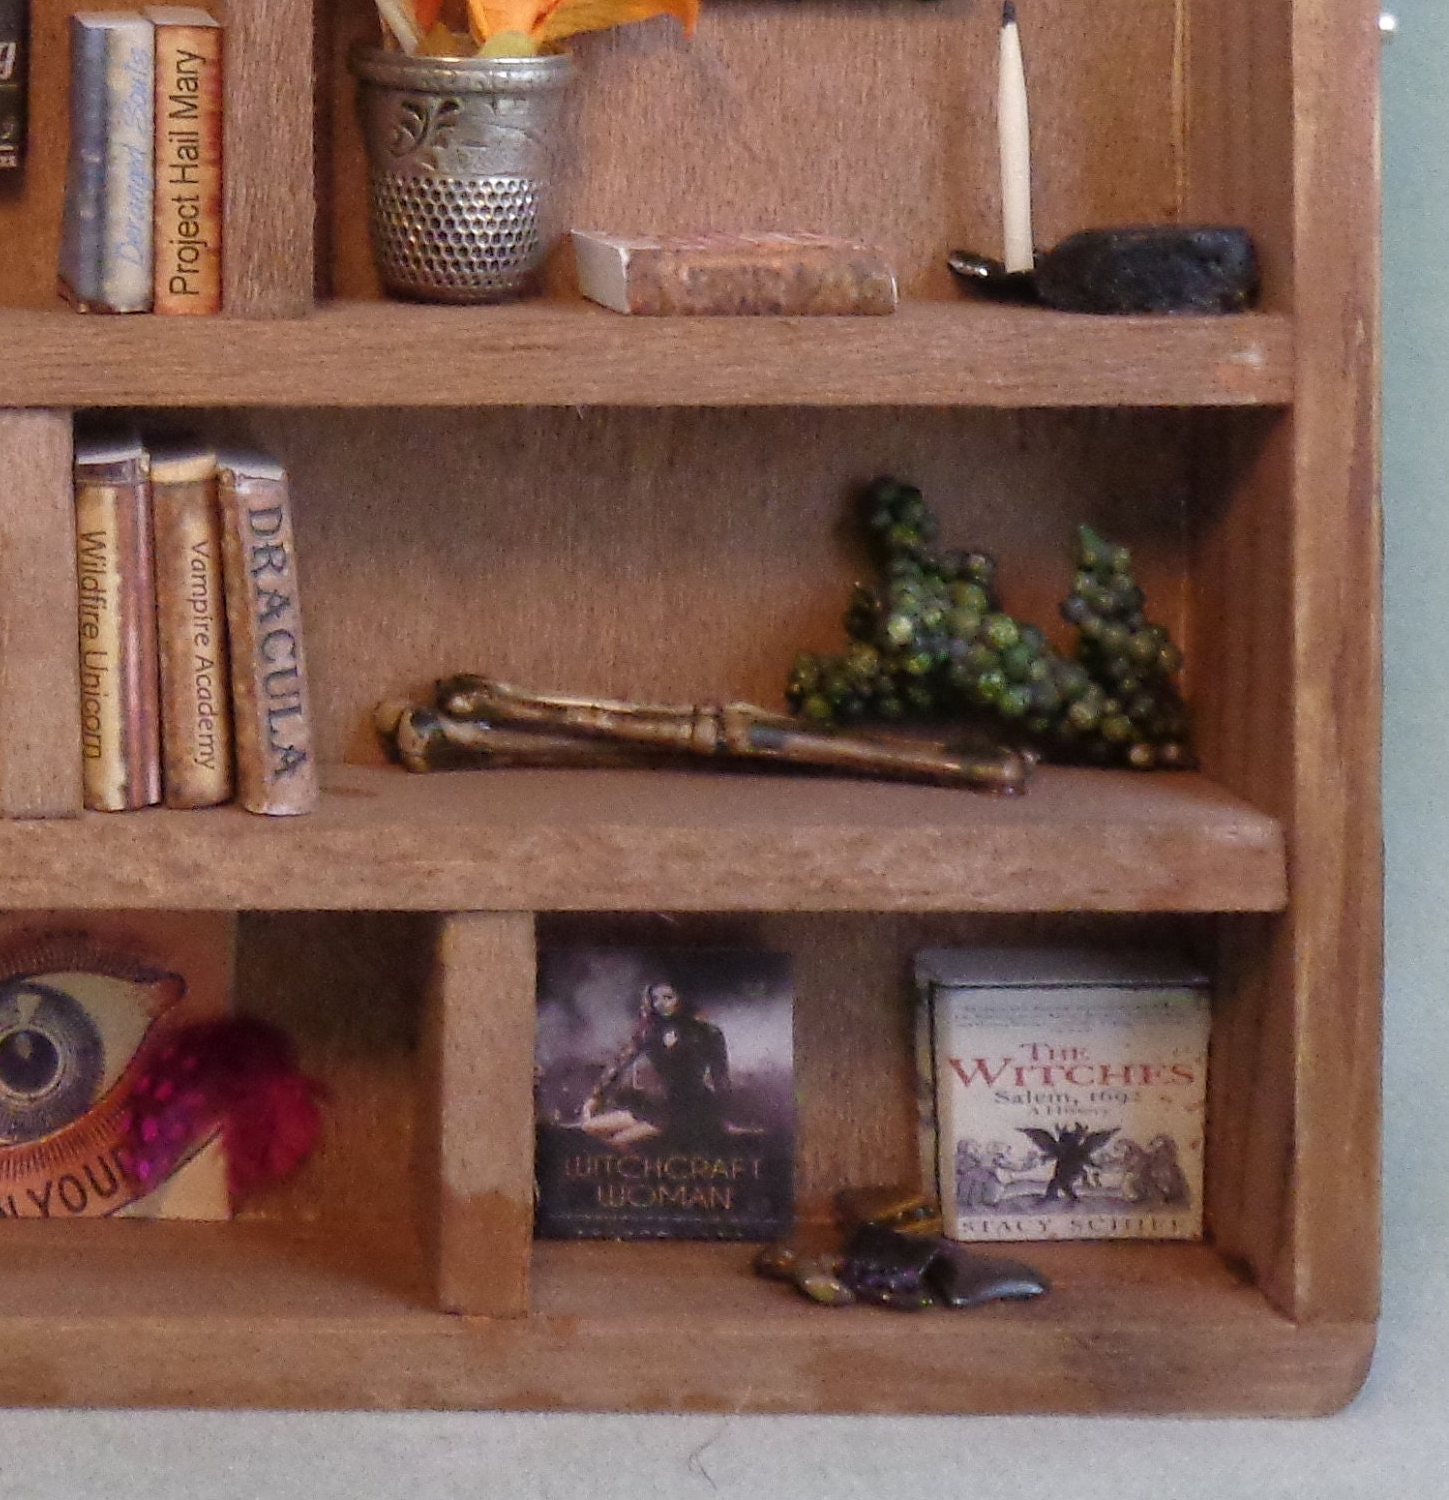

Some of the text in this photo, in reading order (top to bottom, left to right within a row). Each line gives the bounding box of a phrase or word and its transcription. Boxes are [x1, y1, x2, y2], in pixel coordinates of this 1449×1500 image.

[169, 50, 206, 296] Project Hail Mary
[80, 531, 109, 759] Wildfire Unicorn
[186, 541, 216, 771] Vampire Academy
[248, 506, 307, 778] DRACULA
[564, 1154, 762, 1181] WITCHCRAFT
[947, 1057, 1197, 1089] WITCHES
[596, 1185, 735, 1210] WOMAN
